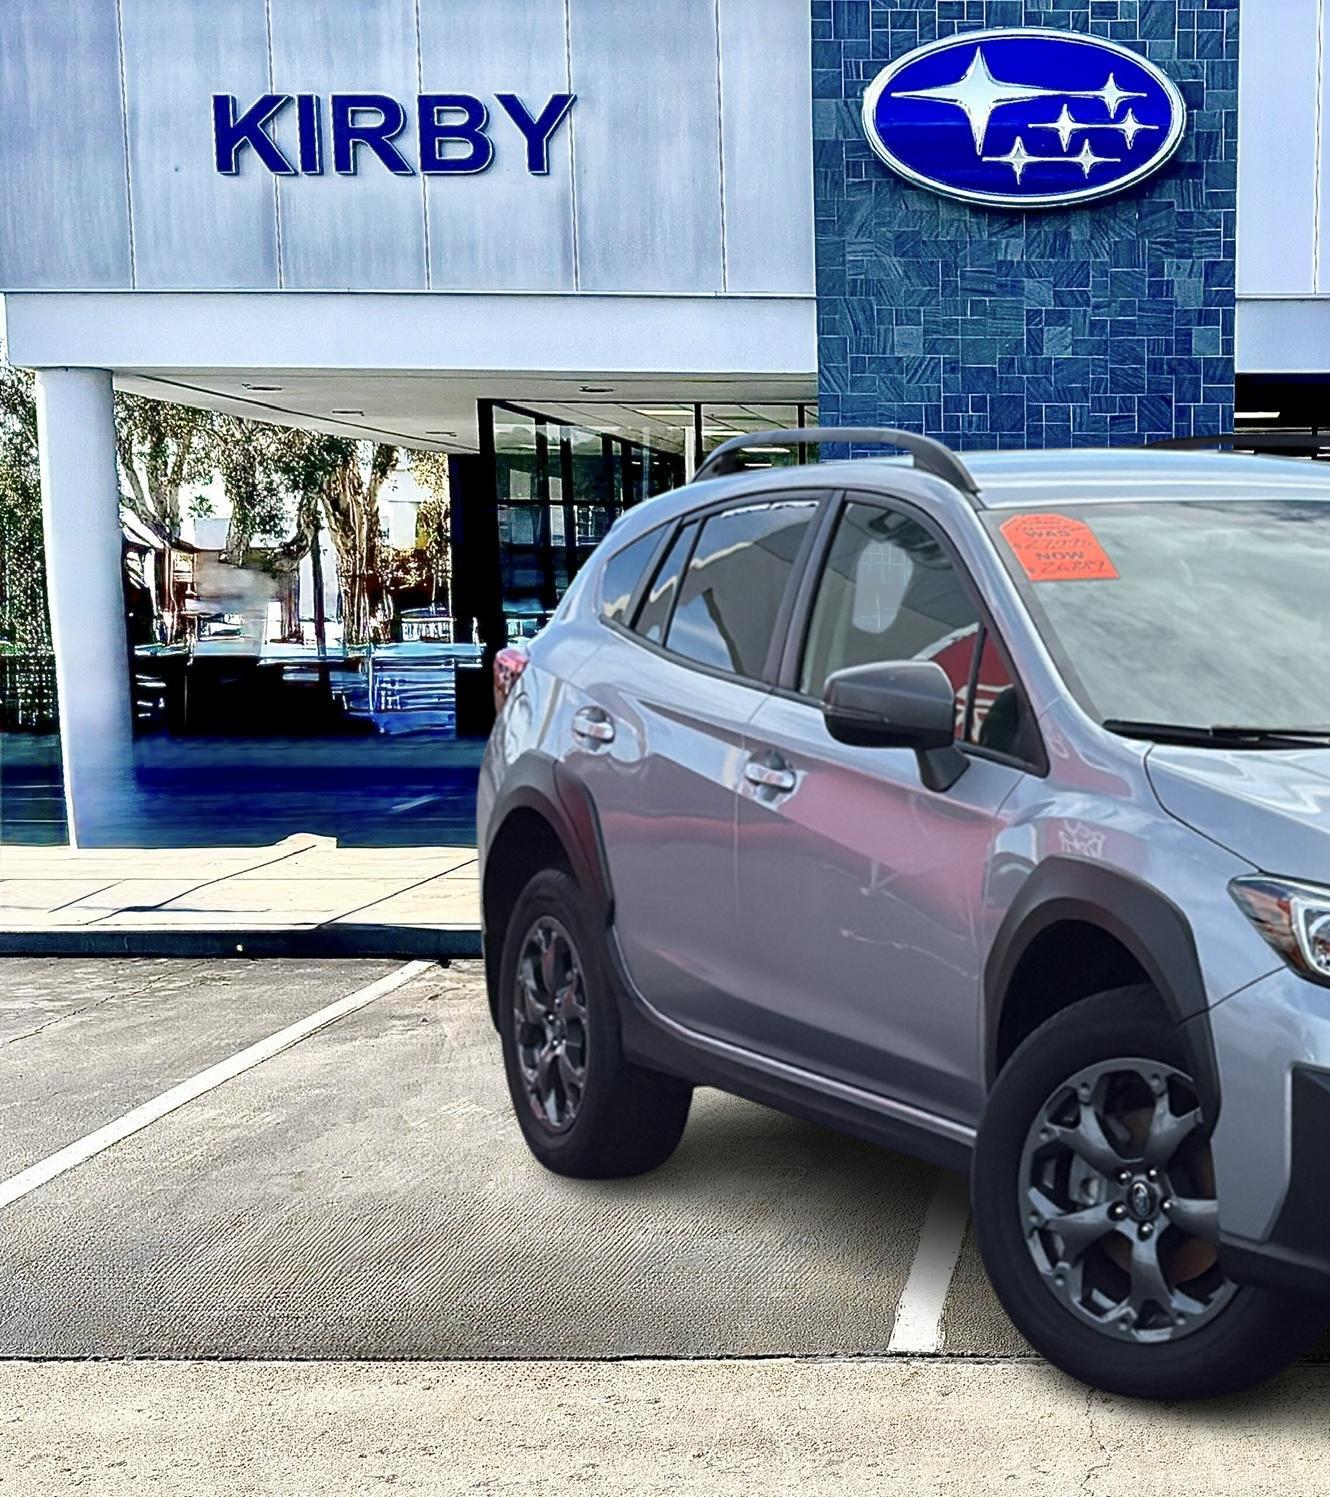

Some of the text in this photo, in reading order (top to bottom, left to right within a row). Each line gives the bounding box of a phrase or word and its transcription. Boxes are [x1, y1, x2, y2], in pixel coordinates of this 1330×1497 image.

[212, 93, 578, 176] KIRBY
[1025, 530, 1073, 538] WAS
[1035, 551, 1085, 561] NOW
